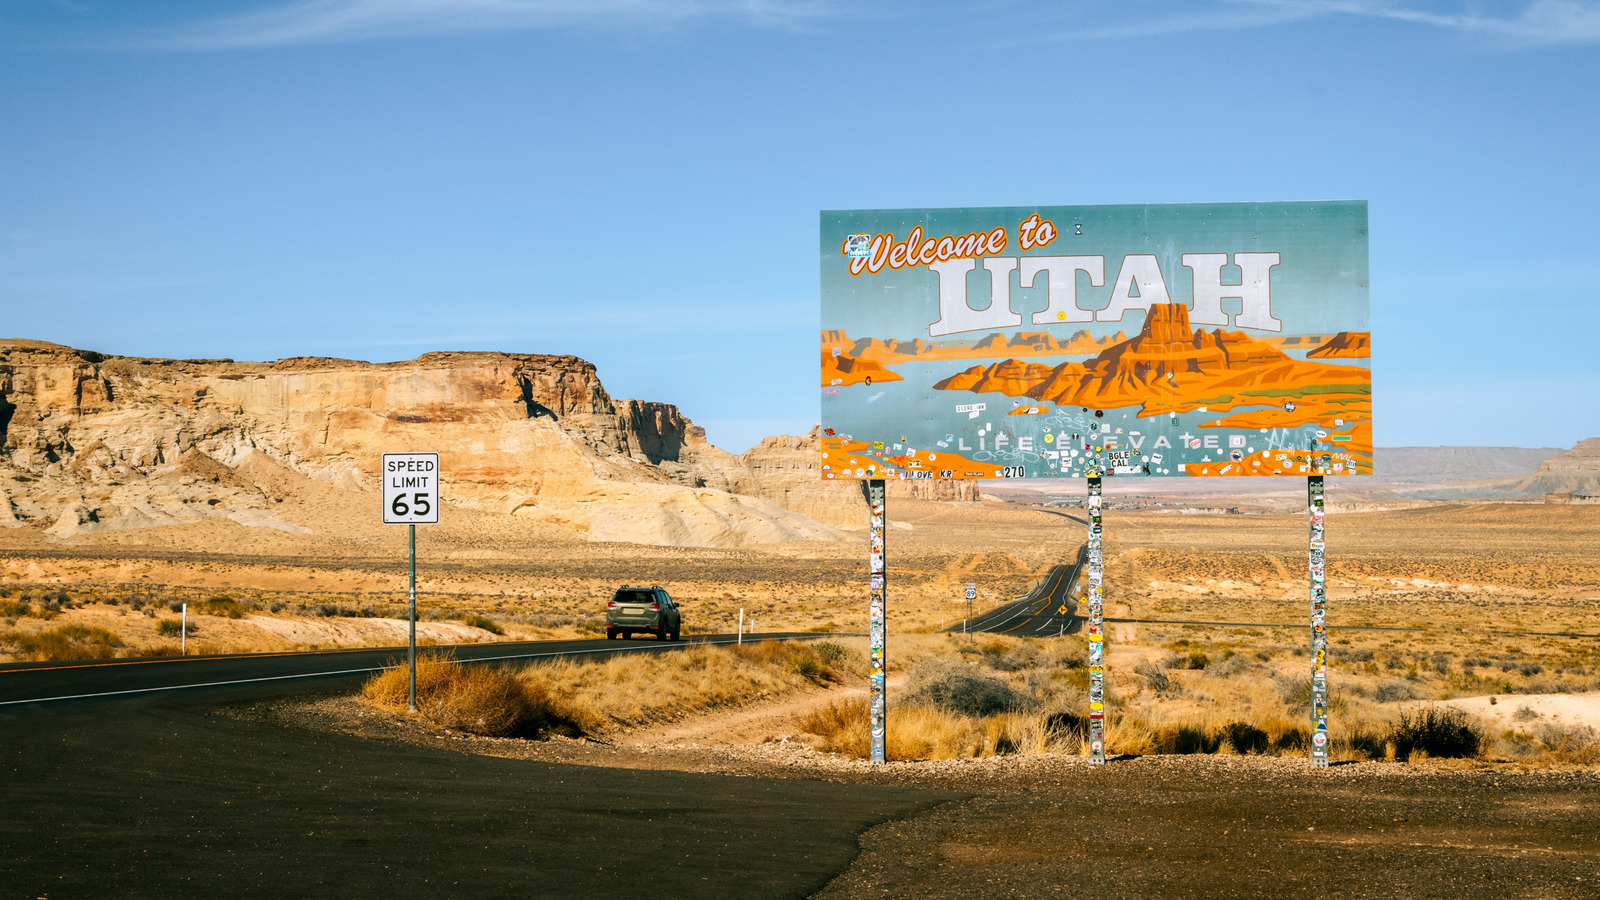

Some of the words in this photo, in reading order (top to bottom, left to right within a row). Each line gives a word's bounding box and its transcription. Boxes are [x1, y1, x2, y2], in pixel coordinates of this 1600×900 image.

[842, 225, 1008, 276] Welcome
[1018, 213, 1057, 251] to
[929, 252, 1282, 337] UTAH
[959, 436, 1033, 451] LIFE
[1056, 434, 1247, 450] ELEVATED
[1108, 451, 1130, 460] BGLE
[388, 460, 434, 472] SPEED
[1111, 459, 1128, 467] CAL
[1004, 466, 1025, 478] 270
[393, 477, 428, 488] LIMIT
[392, 493, 430, 516] 65
